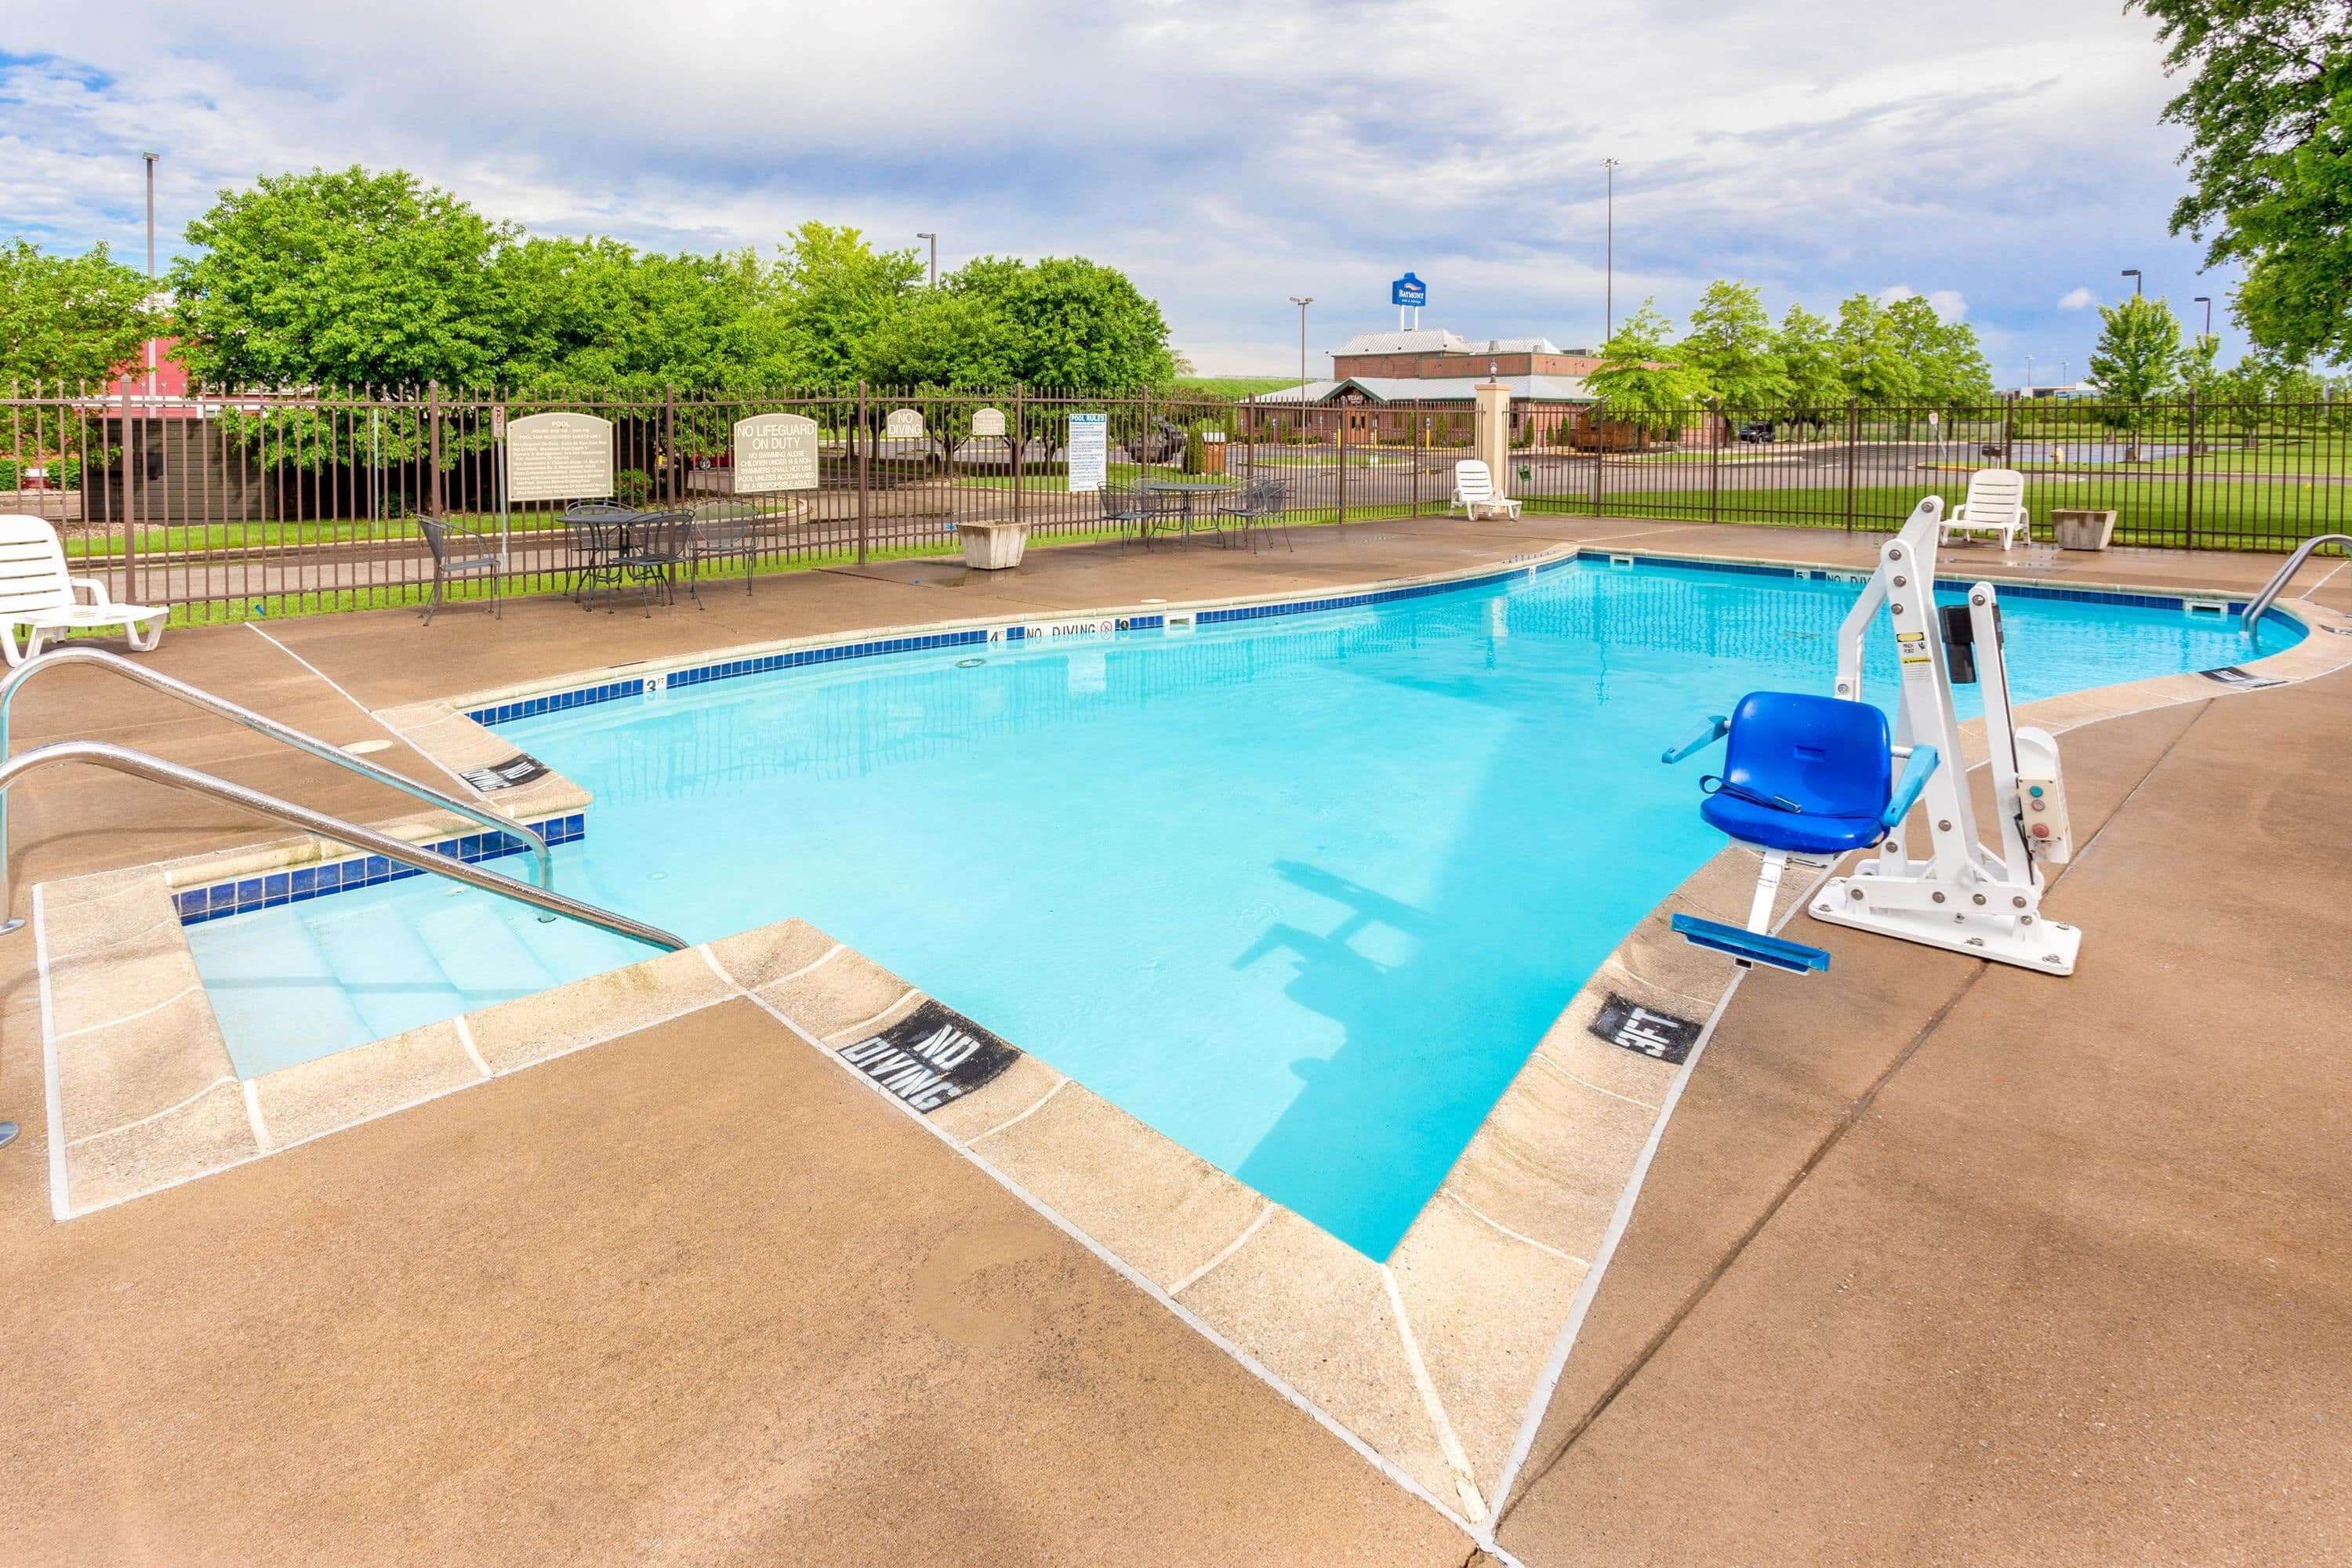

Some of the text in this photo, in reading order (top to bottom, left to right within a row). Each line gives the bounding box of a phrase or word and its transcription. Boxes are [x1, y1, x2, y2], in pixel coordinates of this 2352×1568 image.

[898, 412, 913, 423] NO
[737, 423, 815, 437] NO LIFEGUARD
[889, 424, 922, 434] DIVING
[753, 437, 800, 450] ON DUTY
[738, 470, 815, 482] POOL UNLESS ACCOMPANIED
[740, 466, 771, 475] SWIMMERS
[756, 480, 794, 488] RESPONSIBLE
[1827, 574, 1841, 583] NO
[989, 631, 998, 641] 4
[1026, 627, 1041, 638] NO
[1052, 624, 1095, 636] DIVING
[647, 680, 656, 691] 3
[498, 761, 535, 779] NO
[914, 1024, 981, 1071] NO
[839, 1036, 963, 1111] DIVING
